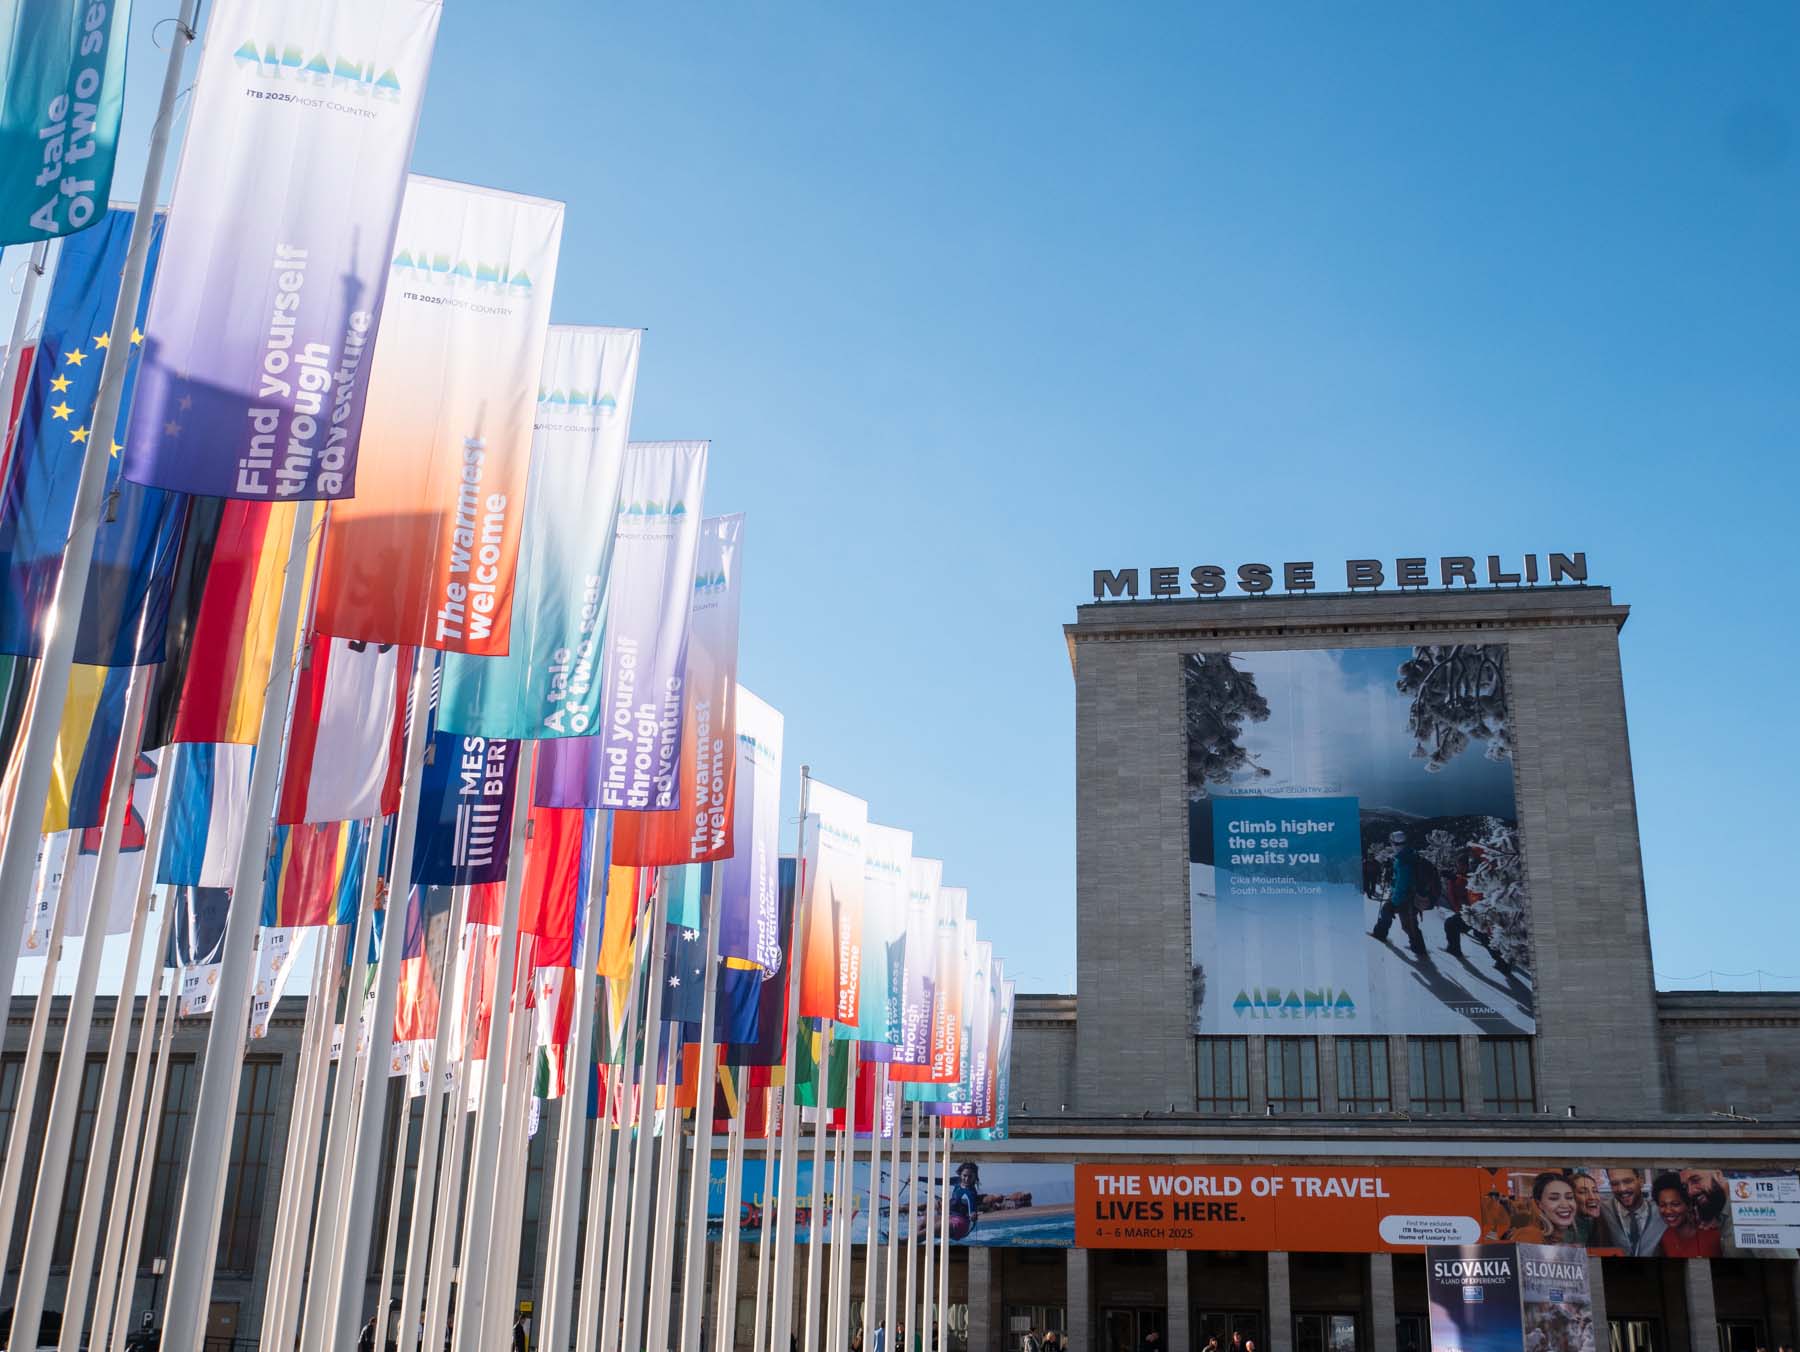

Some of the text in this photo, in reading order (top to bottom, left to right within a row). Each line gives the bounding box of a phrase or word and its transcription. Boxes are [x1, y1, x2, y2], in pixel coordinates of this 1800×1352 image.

[80, 0, 107, 57] se
[64, 67, 100, 165] two
[246, 88, 263, 99] ITB
[326, 102, 378, 120] COUNTRY
[30, 93, 70, 233] A tale
[403, 291, 418, 300] ITB
[236, 242, 309, 495] Find yourself
[275, 342, 332, 497] through
[316, 310, 372, 495] adventure
[436, 436, 487, 642] The warmest
[468, 492, 507, 641] welcome
[1093, 552, 1588, 598] MESSE BERLIN
[543, 647, 571, 733] A tale
[568, 639, 593, 695] two
[602, 634, 639, 807] Find yourself
[655, 675, 682, 809] adventure
[459, 736, 486, 795] MES
[628, 703, 659, 809] through
[690, 701, 711, 859] The warmest
[708, 737, 726, 850] welcome
[1228, 820, 1336, 835] Climb higher
[1228, 836, 1289, 849] the sea
[1231, 851, 1320, 866] awaits you
[1252, 876, 1297, 885] Mountain,
[1230, 886, 1257, 895] South
[271, 935, 284, 945] ITB
[194, 995, 207, 1005] ITB
[837, 990, 848, 1019] The
[847, 944, 860, 1019] welcome
[1233, 986, 1355, 1007] ALBANIA
[255, 1001, 270, 1011] ITB
[917, 990, 931, 1064] adventure
[905, 1003, 920, 1063] through
[944, 1014, 955, 1077] welcome
[932, 1052, 943, 1080] The
[974, 1052, 985, 1115] adventure
[1094, 1175, 1391, 1198] THE WORLD OF TRAVEL
[1755, 1182, 1774, 1192] ITB
[1096, 1200, 1246, 1221] LIVES HERE.
[1096, 1227, 1103, 1237] 4
[1114, 1227, 1121, 1238] 6
[1124, 1228, 1165, 1238] MARCH
[1168, 1228, 1193, 1239] 2025
[1434, 1261, 1511, 1277] SLOVAKIA
[1469, 1277, 1506, 1285] EXPERIENCES
[1526, 1261, 1584, 1280] SLOVAKIA
[143, 1312, 153, 1326] P
